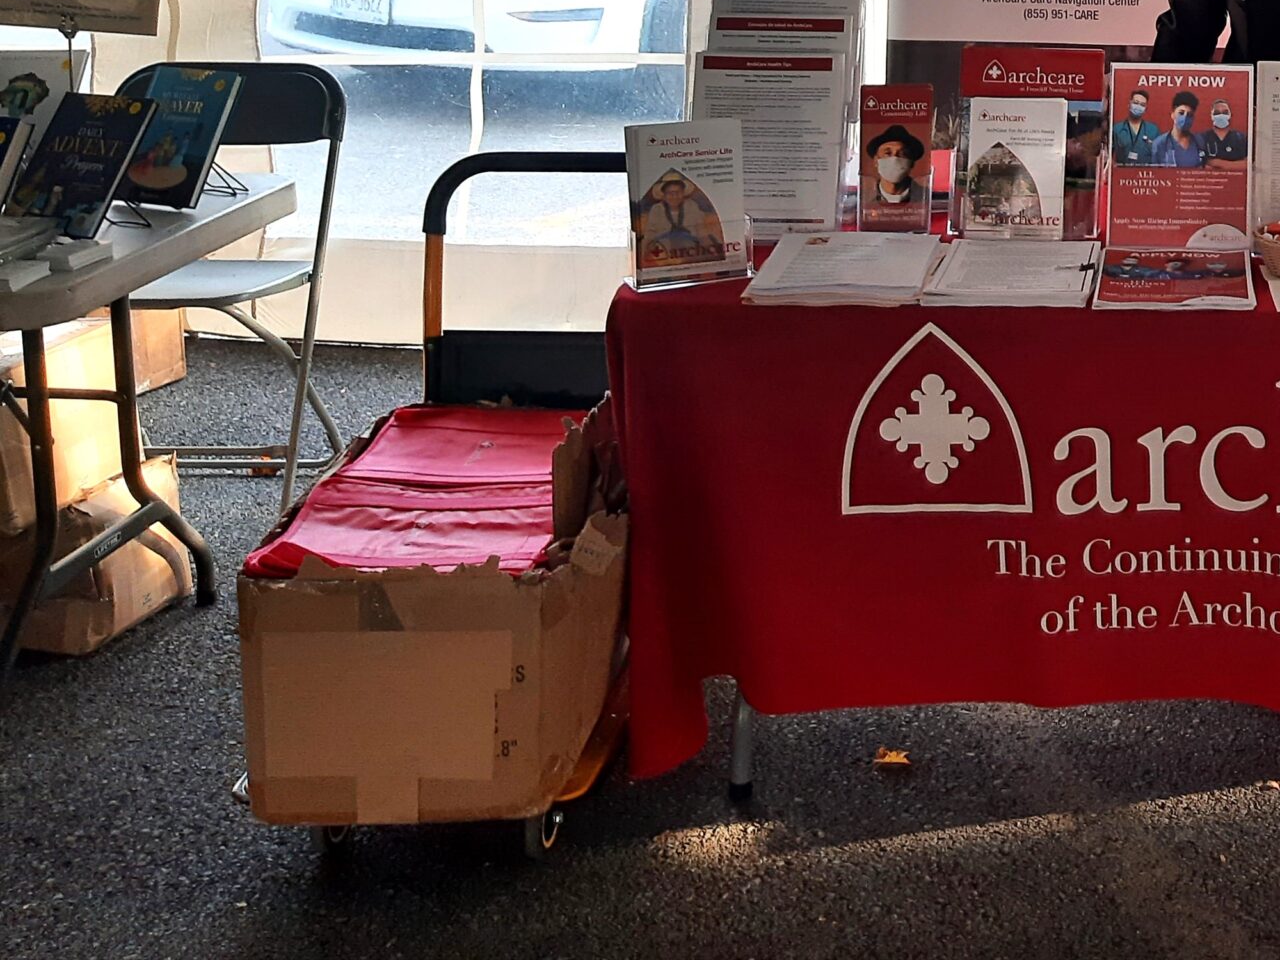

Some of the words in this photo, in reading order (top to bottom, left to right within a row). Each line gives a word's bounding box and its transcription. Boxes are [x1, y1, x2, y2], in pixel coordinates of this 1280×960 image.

[1024, 9, 1049, 20] (855)
[1051, 9, 1099, 20] 951-CARE
[1008, 67, 1085, 85] archcare
[1138, 74, 1183, 88] APPLY
[1188, 75, 1226, 88] NOW
[880, 99, 928, 111] archcare
[990, 112, 1027, 122] archcare
[660, 135, 700, 146] archcare
[660, 151, 694, 159] ArchCare
[695, 148, 717, 156] Senior
[719, 147, 733, 155] Life
[1137, 170, 1155, 178] ALL
[1119, 179, 1172, 187] POSITIONS
[1132, 187, 1158, 195] OPEN
[987, 540, 1065, 578] The
[1041, 596, 1084, 634] of
[1093, 594, 1157, 629] the
